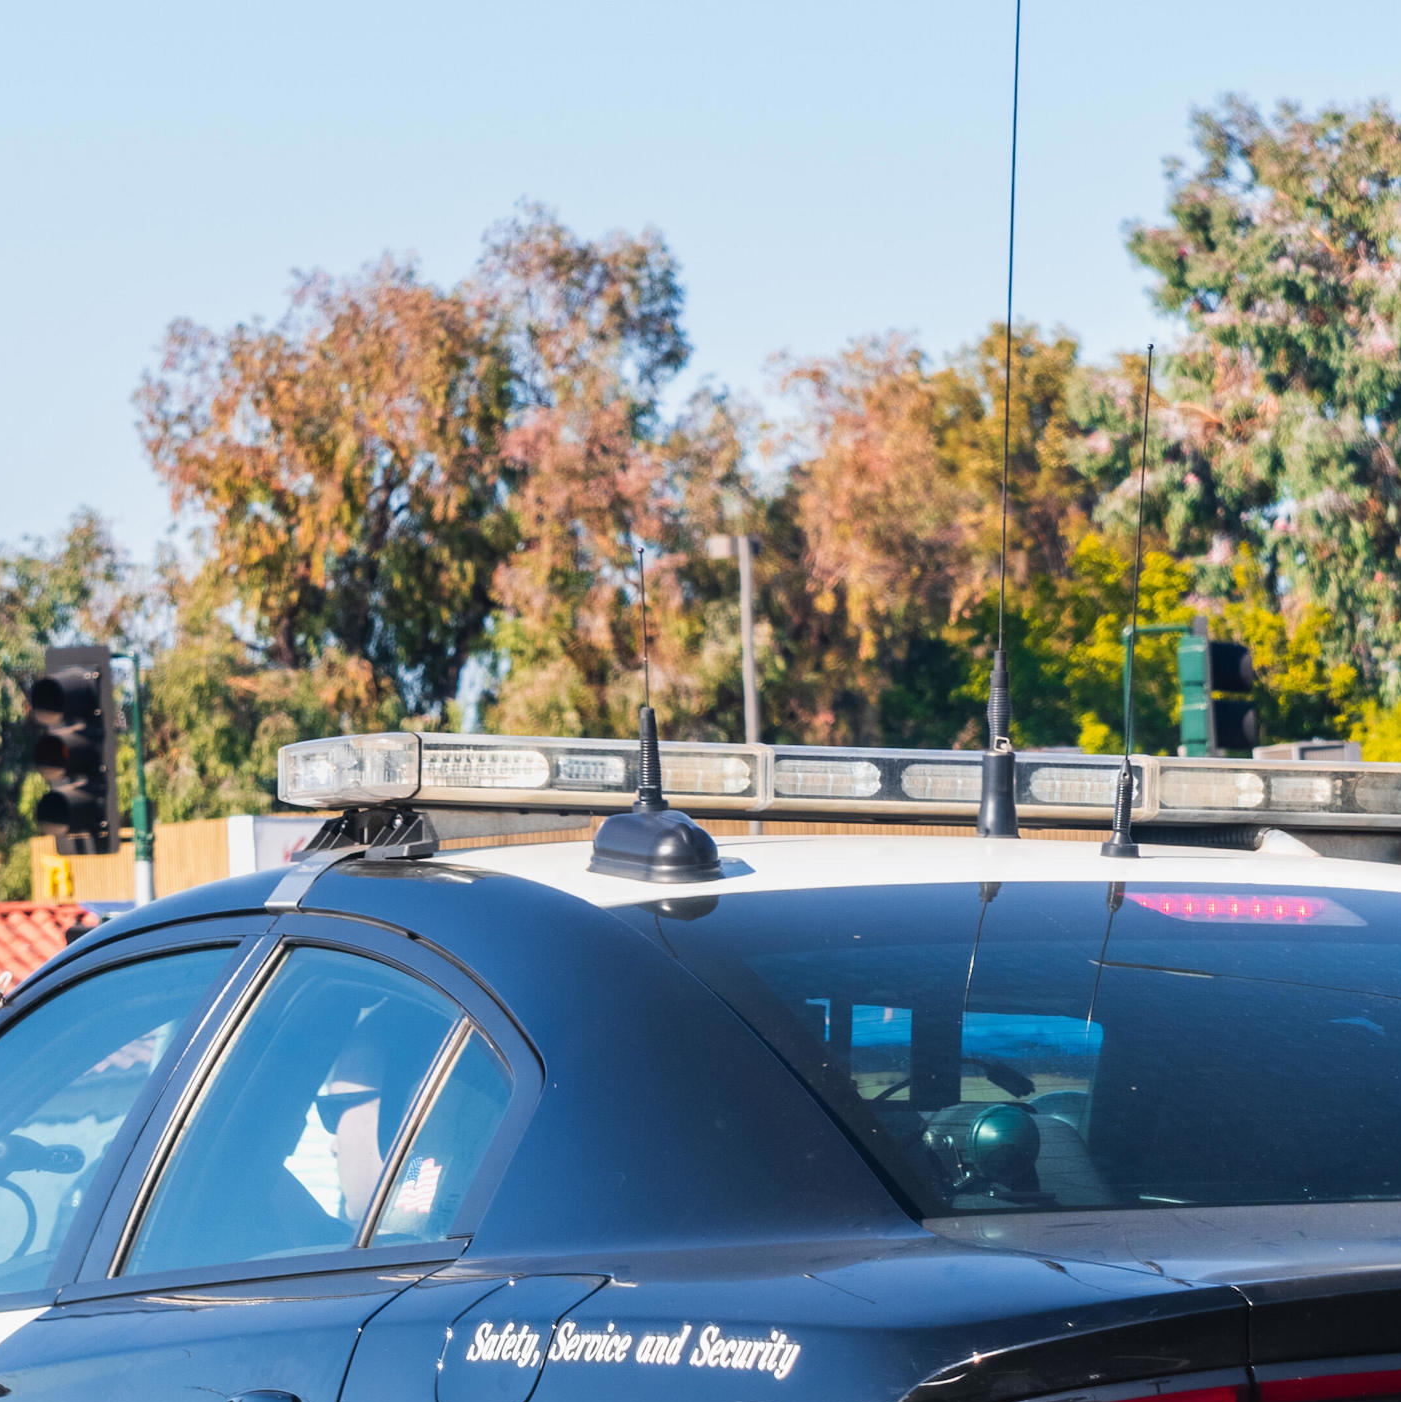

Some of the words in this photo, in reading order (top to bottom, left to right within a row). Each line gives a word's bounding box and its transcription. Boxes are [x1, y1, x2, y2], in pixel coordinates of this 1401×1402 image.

[466, 1322, 541, 1368] Safety,
[548, 1321, 633, 1363] Service
[635, 1323, 693, 1366] and
[688, 1323, 801, 1380] Security
